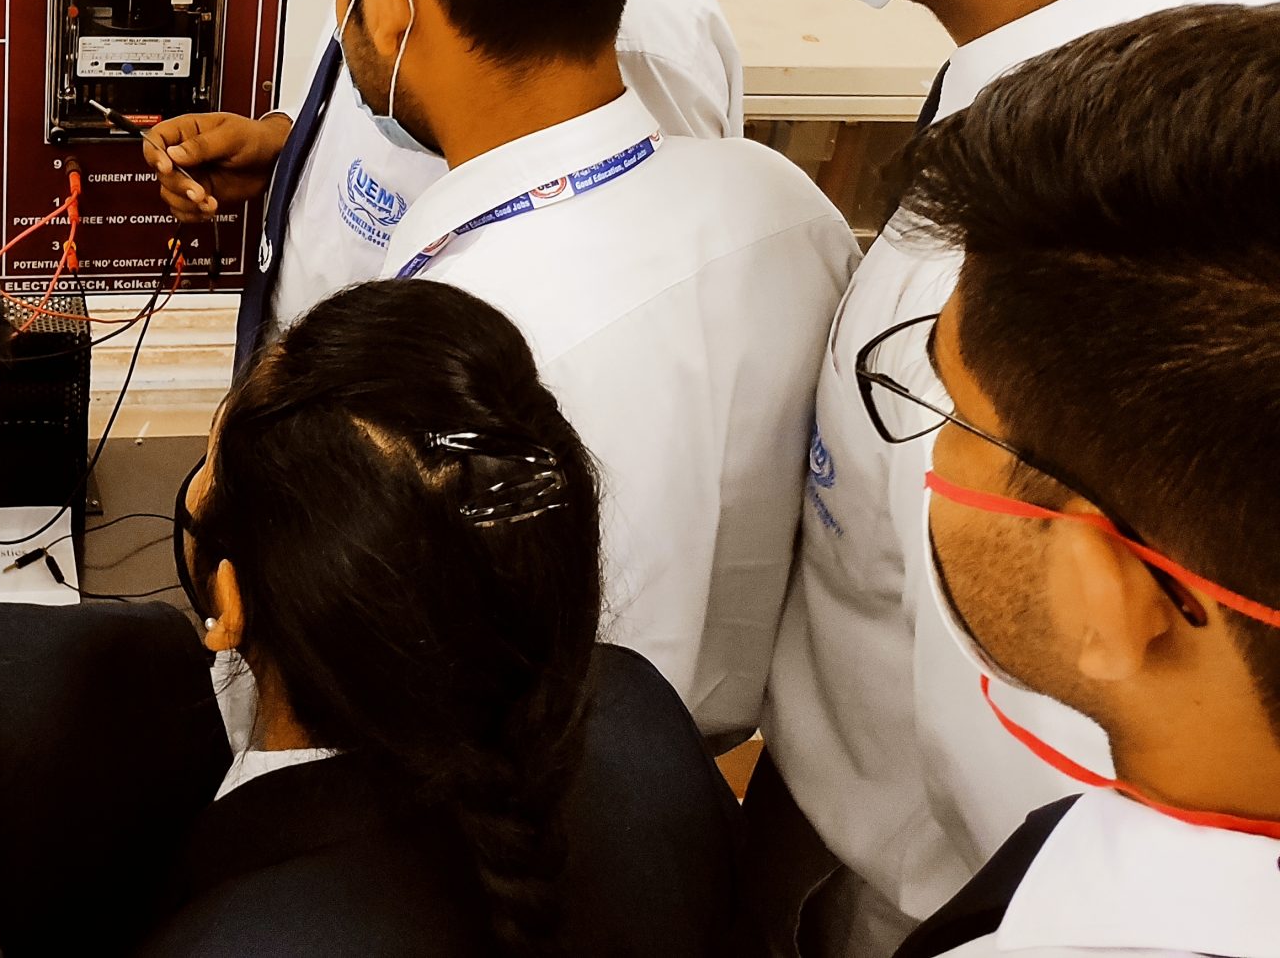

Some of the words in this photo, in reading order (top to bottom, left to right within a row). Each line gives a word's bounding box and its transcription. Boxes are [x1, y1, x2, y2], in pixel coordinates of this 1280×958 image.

[53, 159, 63, 170] 9
[575, 176, 593, 190] Good
[592, 163, 625, 183] Education,
[623, 154, 637, 168] Good
[87, 173, 133, 183] CURRENT
[134, 173, 158, 182] INPU
[356, 167, 395, 209] UEM
[52, 197, 60, 207] 1
[494, 204, 512, 218] Good
[512, 199, 531, 212] Jobs
[106, 216, 128, 224] 'NO'
[51, 241, 60, 251] 3
[190, 238, 199, 248] 4
[13, 260, 65, 269] POTENTIA
[92, 259, 111, 268] 'NO'
[112, 258, 156, 268] CONTACT
[220, 257, 237, 266] RIP'
